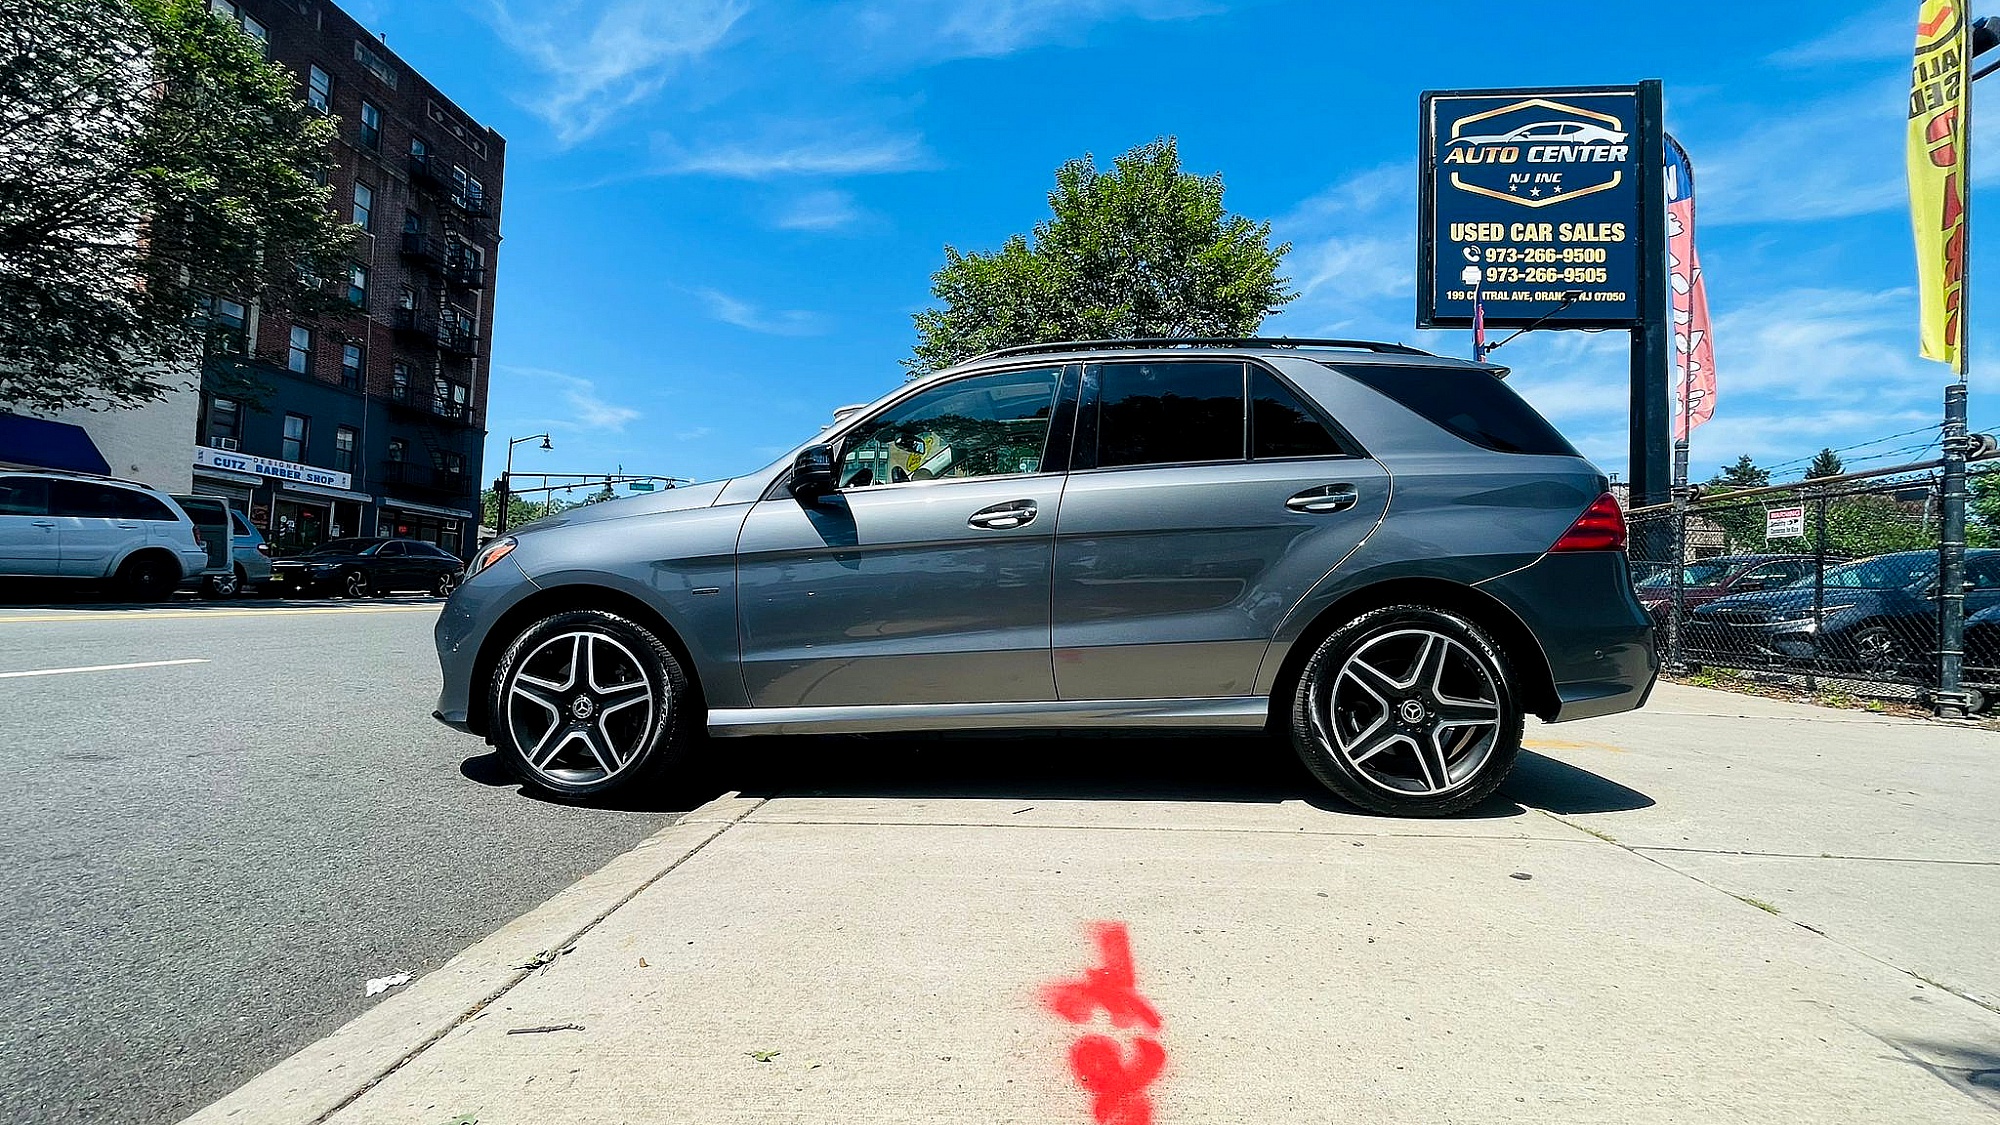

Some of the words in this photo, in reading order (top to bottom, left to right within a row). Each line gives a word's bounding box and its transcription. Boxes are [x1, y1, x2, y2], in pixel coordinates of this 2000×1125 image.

[1444, 146, 1519, 164] AUTO
[1527, 145, 1629, 163] CENTER
[1509, 173, 1529, 183] NJ
[1534, 173, 1563, 183] INC
[1450, 223, 1504, 242] USED
[1510, 223, 1553, 242] CAR
[1559, 223, 1626, 242] SALES
[1485, 248, 1606, 263] 973-266-9500
[1486, 267, 1607, 283] 973-266-9505
[1446, 291, 1465, 300] 199
[1467, 291, 1510, 301] CTRAL
[1511, 291, 1533, 302] AVE,
[1594, 292, 1626, 301] 07050
[214, 456, 246, 470] CUTZ
[255, 464, 302, 479] BARBER
[306, 473, 335, 485] SHOP
